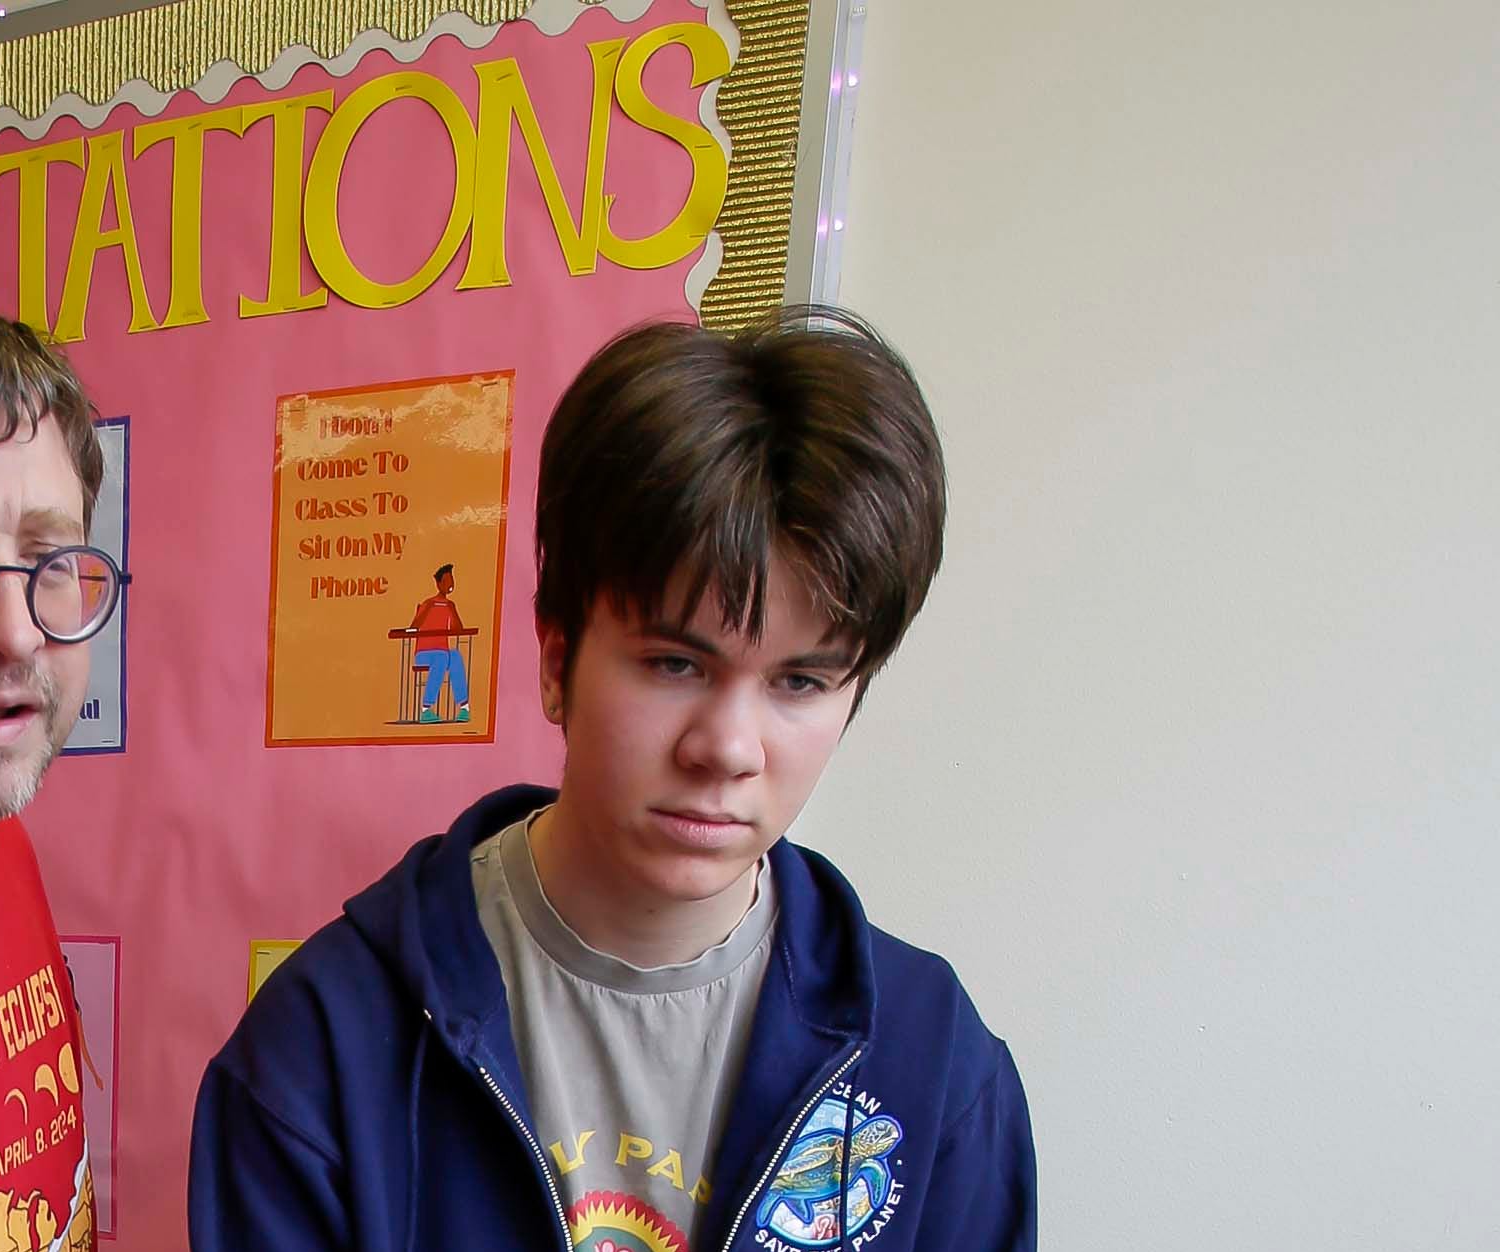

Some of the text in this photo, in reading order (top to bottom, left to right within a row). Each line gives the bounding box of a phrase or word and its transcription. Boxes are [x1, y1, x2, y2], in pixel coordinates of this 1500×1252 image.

[297, 451, 409, 481] Come To
[295, 492, 409, 521] Class To
[298, 532, 407, 560] Sit On My
[311, 576, 389, 599] Phone
[852, 1178, 904, 1252] PLANET
